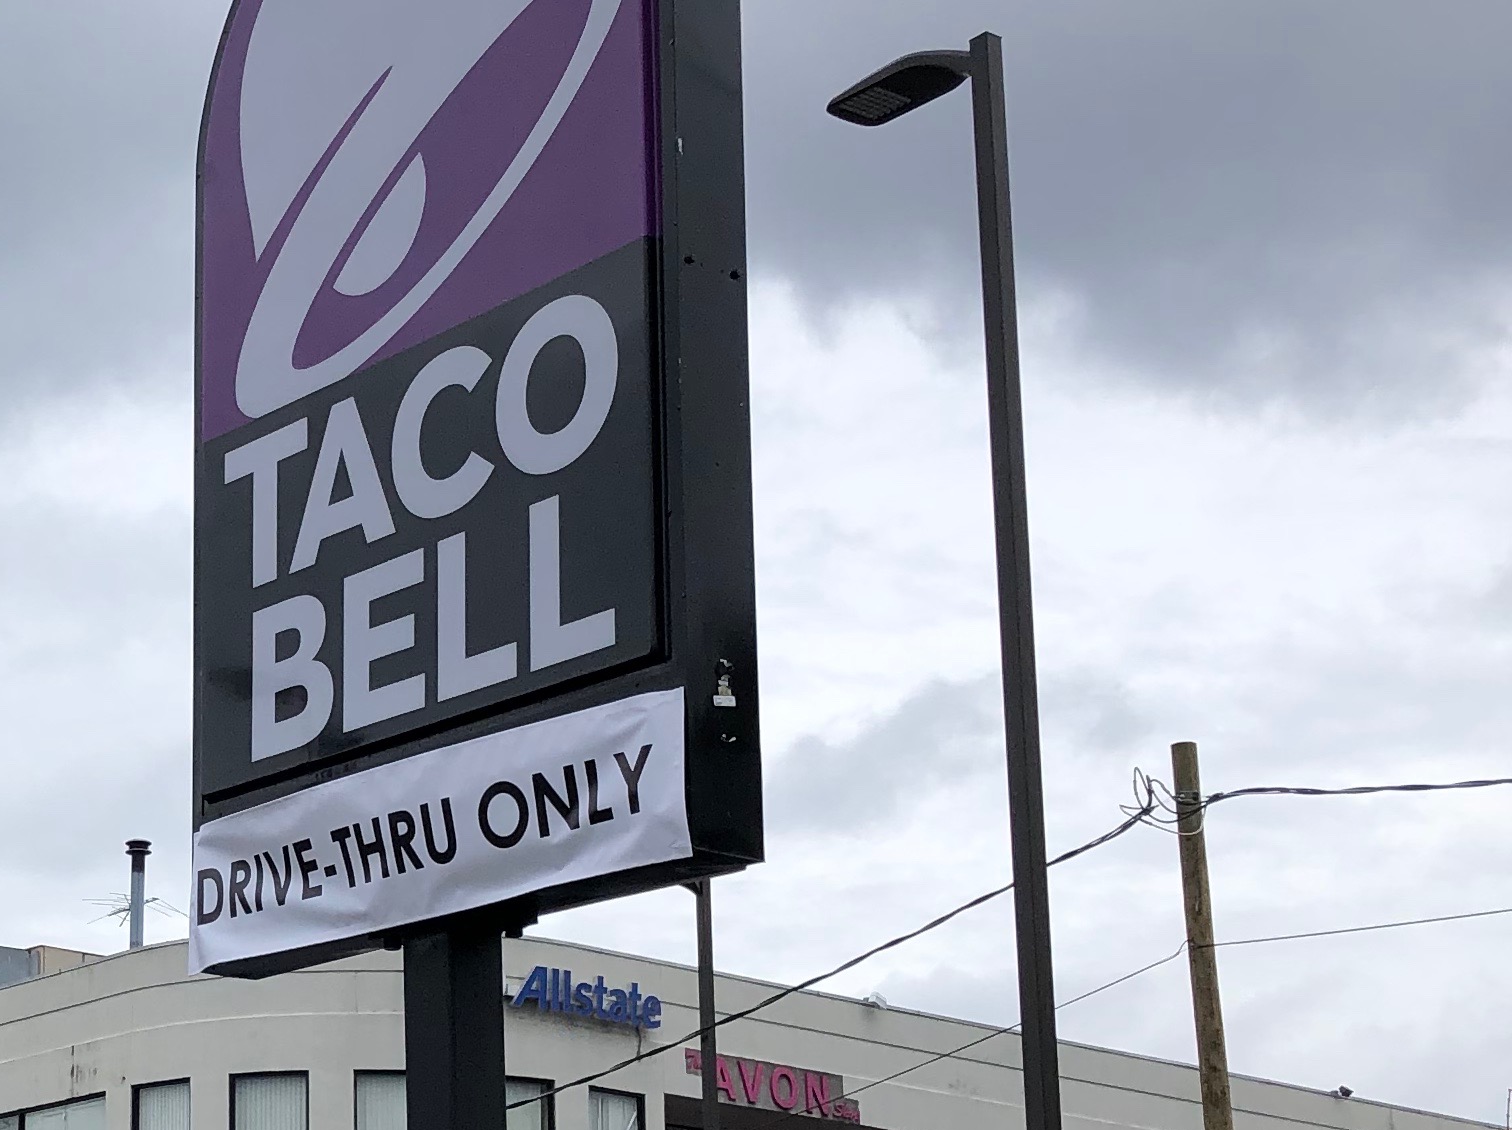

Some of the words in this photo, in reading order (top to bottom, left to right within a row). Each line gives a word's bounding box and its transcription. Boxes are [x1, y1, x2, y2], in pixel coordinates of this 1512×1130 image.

[224, 295, 619, 589] TACO
[251, 494, 616, 762] BELL
[196, 796, 457, 926] DRIVE-THRU
[477, 744, 653, 849] ONLY
[511, 965, 662, 1029] Allstate
[716, 1056, 831, 1117] AVON
